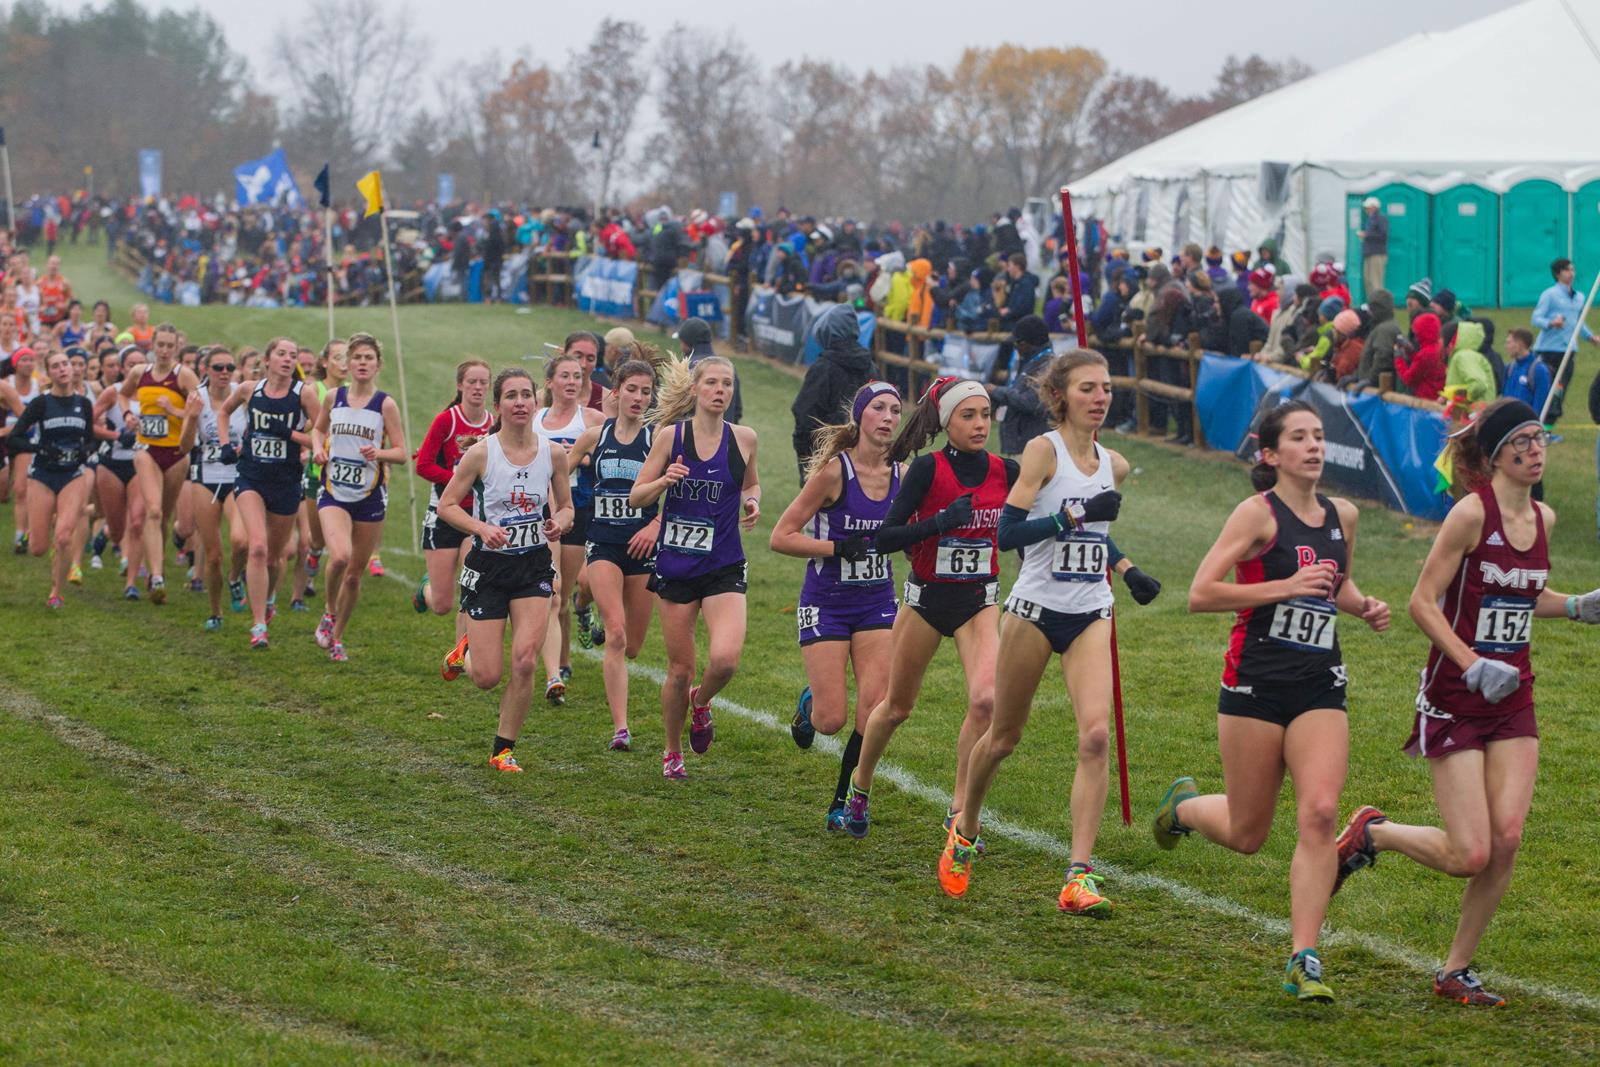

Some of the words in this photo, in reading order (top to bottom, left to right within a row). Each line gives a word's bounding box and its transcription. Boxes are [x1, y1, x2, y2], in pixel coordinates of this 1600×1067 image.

[331, 423, 375, 441] WILLIAMS
[254, 440, 282, 458] 248
[332, 463, 362, 484] 328
[669, 477, 724, 504] NYU
[505, 522, 540, 548] 278
[668, 523, 709, 550] 172
[847, 554, 884, 580] 138
[951, 548, 980, 573] 63
[1060, 543, 1104, 573] 119
[1277, 607, 1331, 646] 197
[1483, 610, 1530, 642] 152
